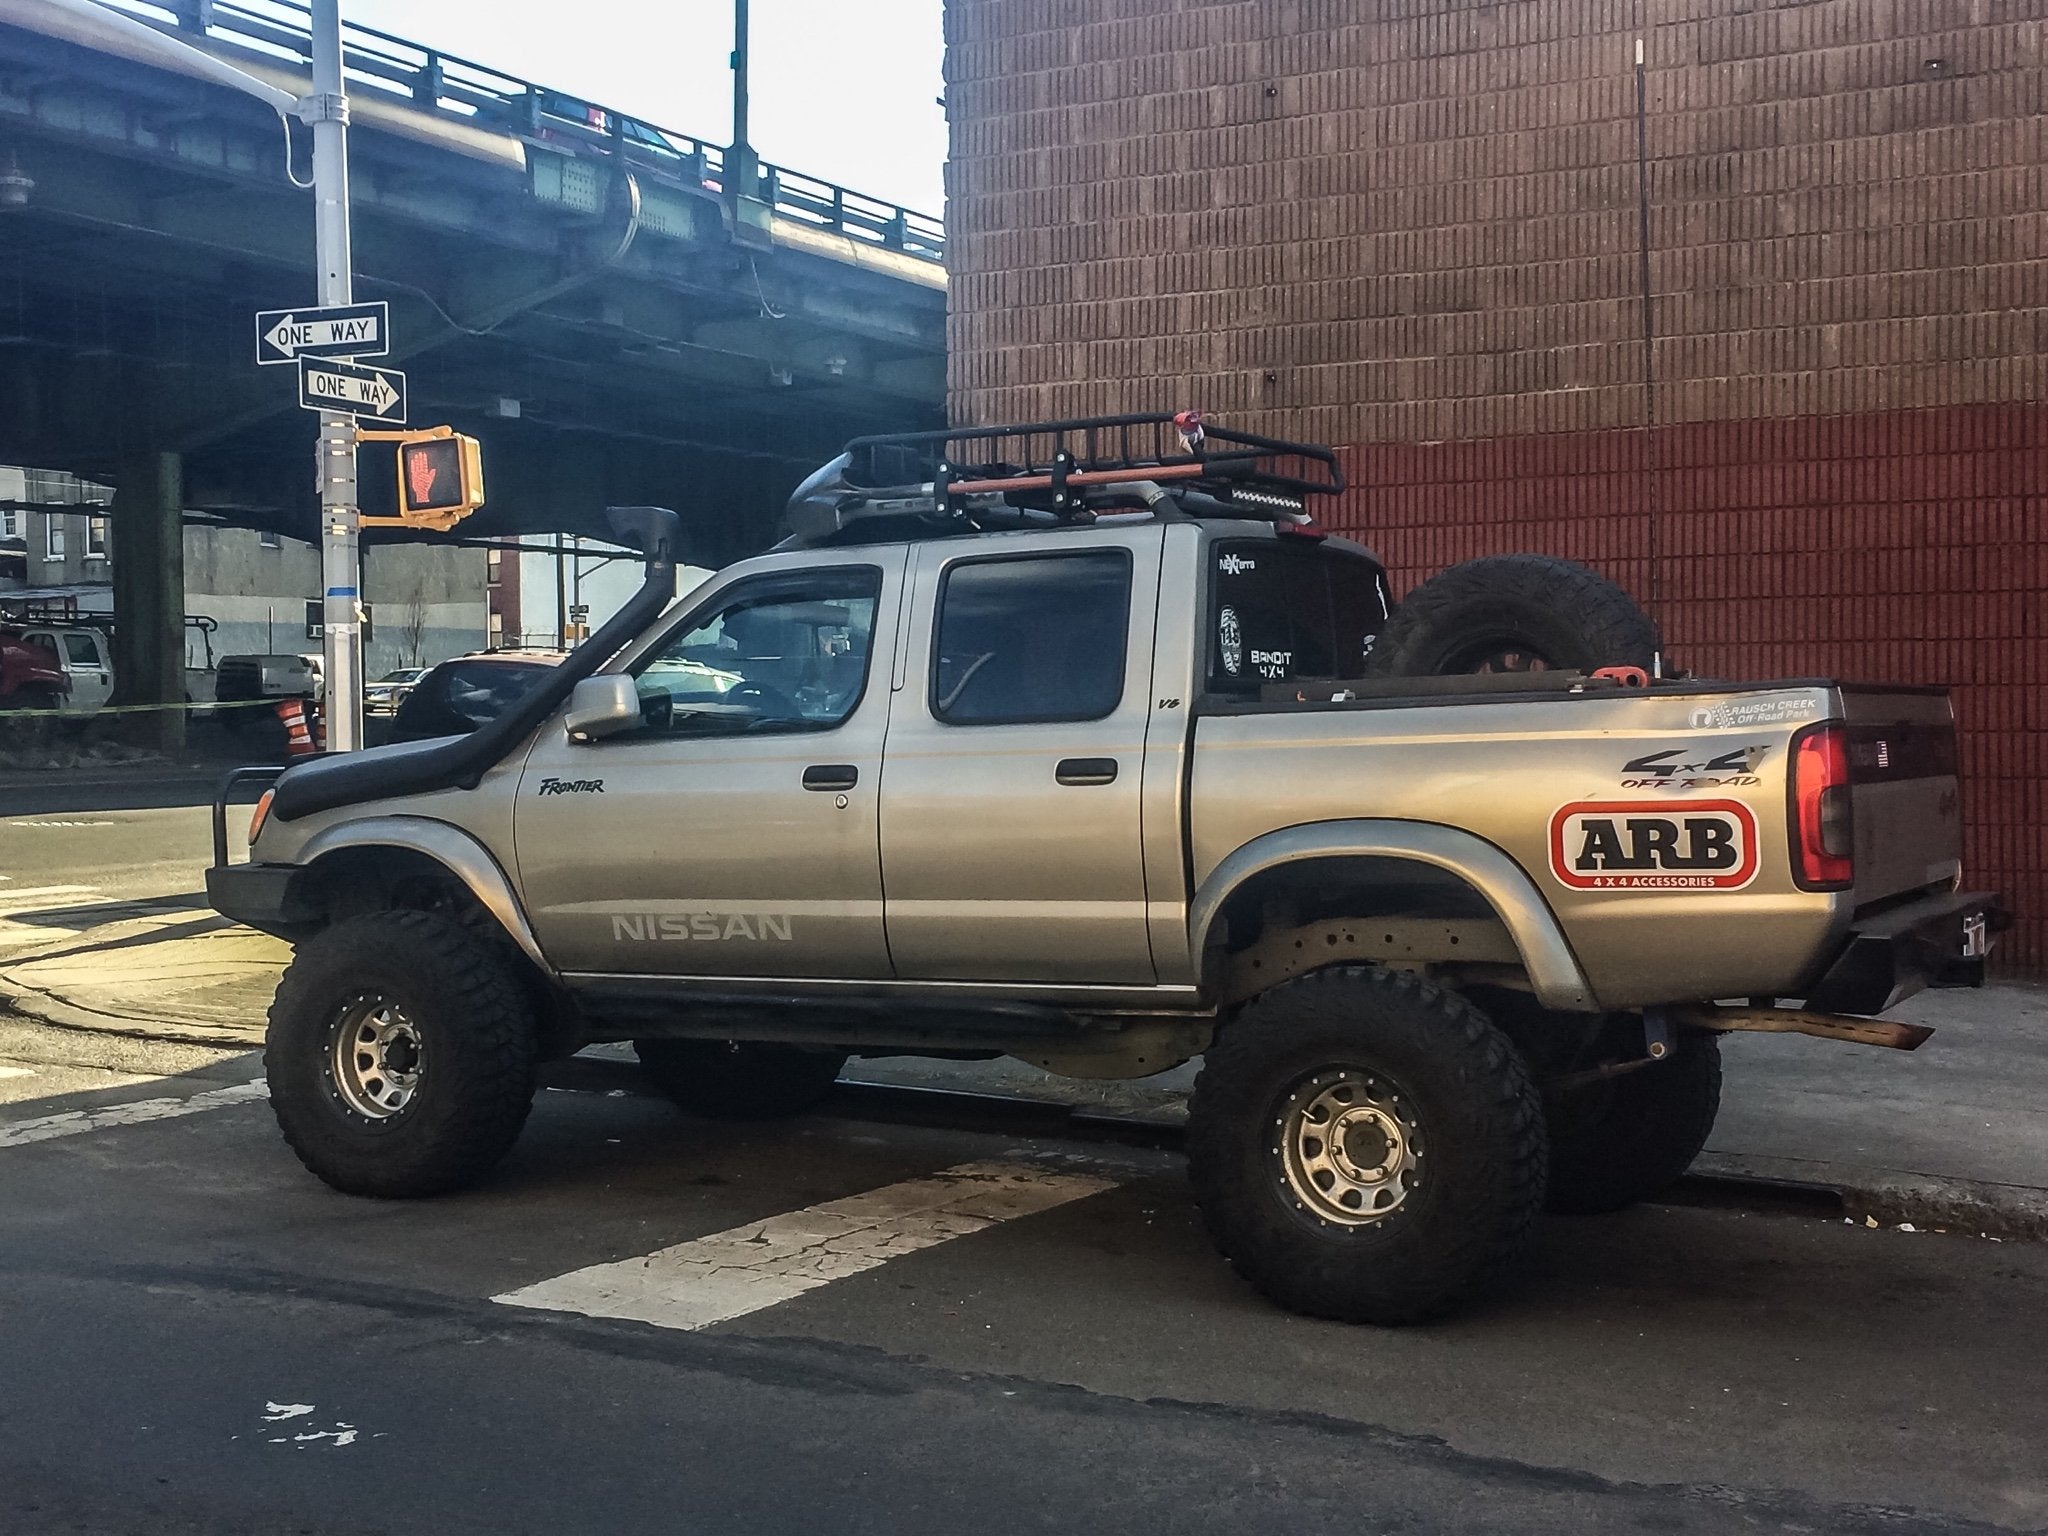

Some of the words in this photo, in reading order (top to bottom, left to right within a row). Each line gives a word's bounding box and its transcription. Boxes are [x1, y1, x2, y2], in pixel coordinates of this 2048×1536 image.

[277, 325, 313, 346] ONE
[331, 320, 369, 342] WAY
[316, 375, 346, 397] ONE
[360, 382, 389, 405] WAY
[1159, 698, 1180, 710] V6
[1732, 702, 1775, 715] RAUSCH
[1777, 699, 1816, 710] CREEK
[1737, 710, 1783, 724] Off-Road
[1786, 709, 1810, 718] Park
[1620, 778, 1676, 789] OFF
[1575, 818, 1738, 870] ARB
[1631, 877, 1716, 888] ACCESSORIES
[611, 914, 793, 941] NISSAN
